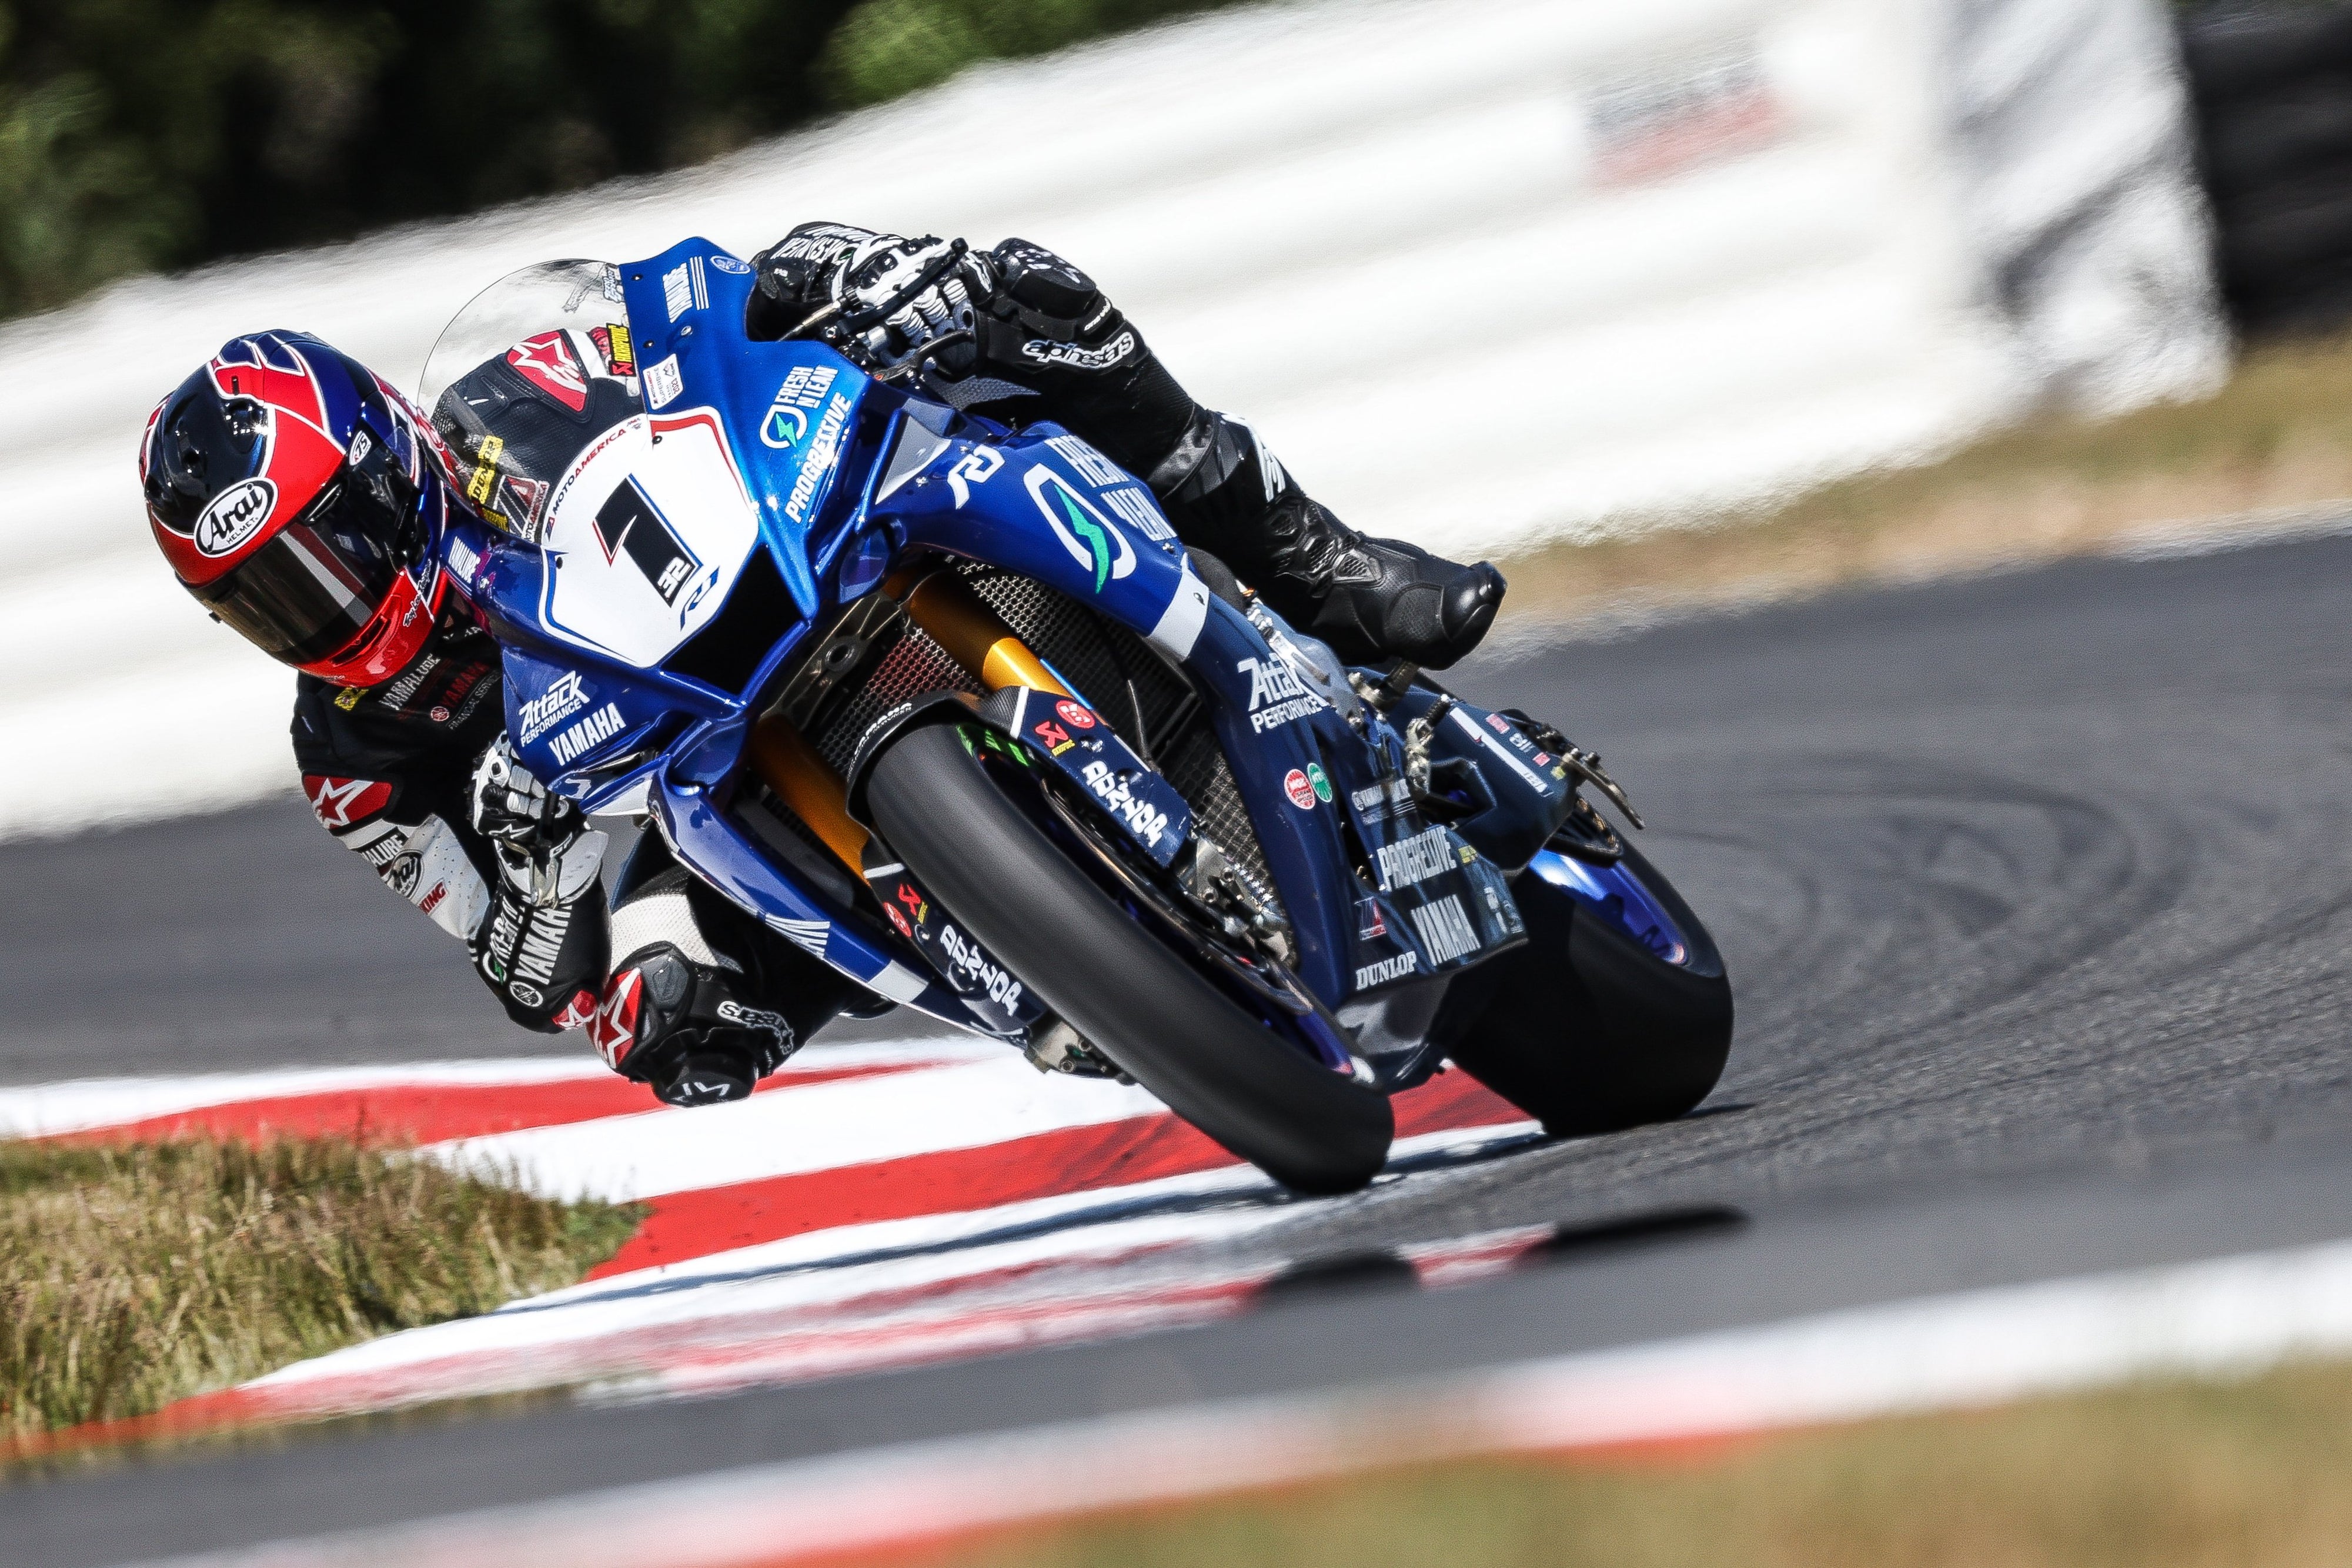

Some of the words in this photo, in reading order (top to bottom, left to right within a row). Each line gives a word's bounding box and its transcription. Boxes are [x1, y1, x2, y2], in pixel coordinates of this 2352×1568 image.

[775, 366, 814, 404] FRESH
[802, 365, 838, 399] LEAN
[553, 429, 627, 515] MOTOAMERICA
[785, 392, 852, 524] PROGRESSIVE
[208, 483, 263, 552] Arai
[227, 516, 256, 544] HELMET
[592, 473, 704, 608] 1
[657, 556, 691, 600] 32
[520, 698, 582, 747] PERFORMANCE
[548, 703, 627, 766] YAMAHA
[1356, 951, 1417, 991] DUNLOP
